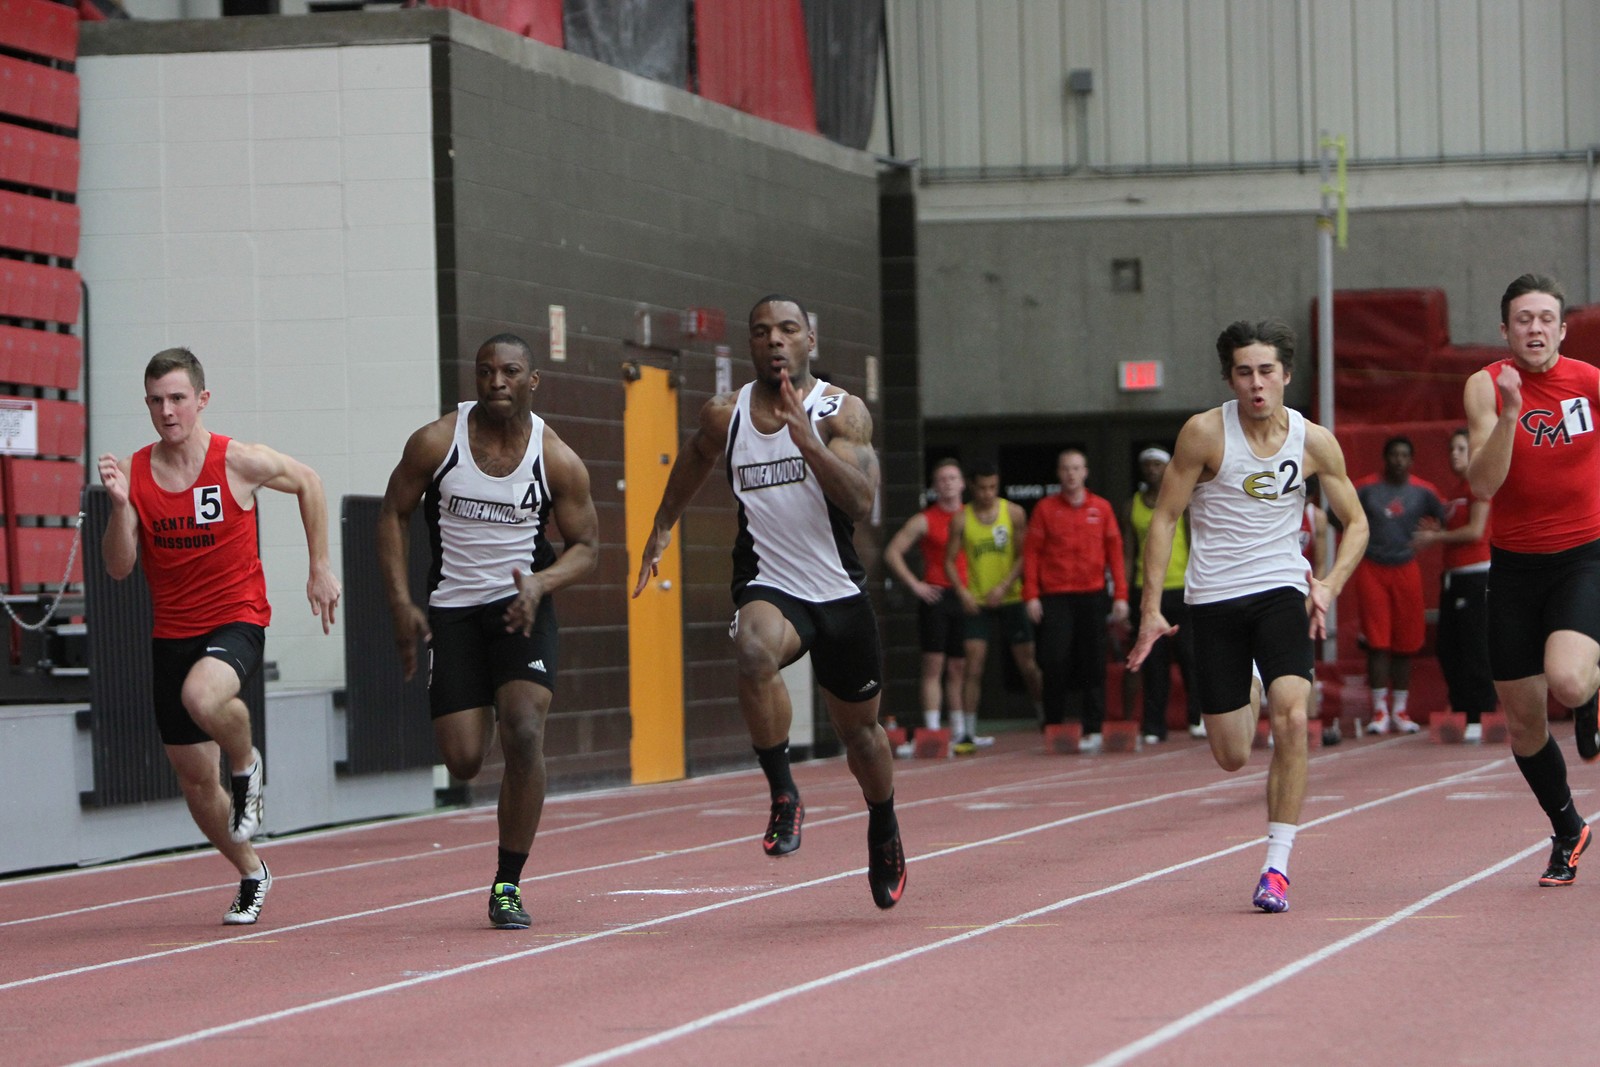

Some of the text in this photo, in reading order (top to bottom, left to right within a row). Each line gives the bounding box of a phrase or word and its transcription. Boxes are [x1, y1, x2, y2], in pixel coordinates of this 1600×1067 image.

[818, 396, 840, 417] 3
[1569, 399, 1588, 431] 1
[739, 458, 805, 490] LINDENWOOD
[1279, 460, 1301, 495] 2
[201, 487, 221, 520] 5
[449, 498, 525, 524] LINDENWOO
[521, 483, 540, 512] 4
[153, 534, 216, 549] MISSOURI
